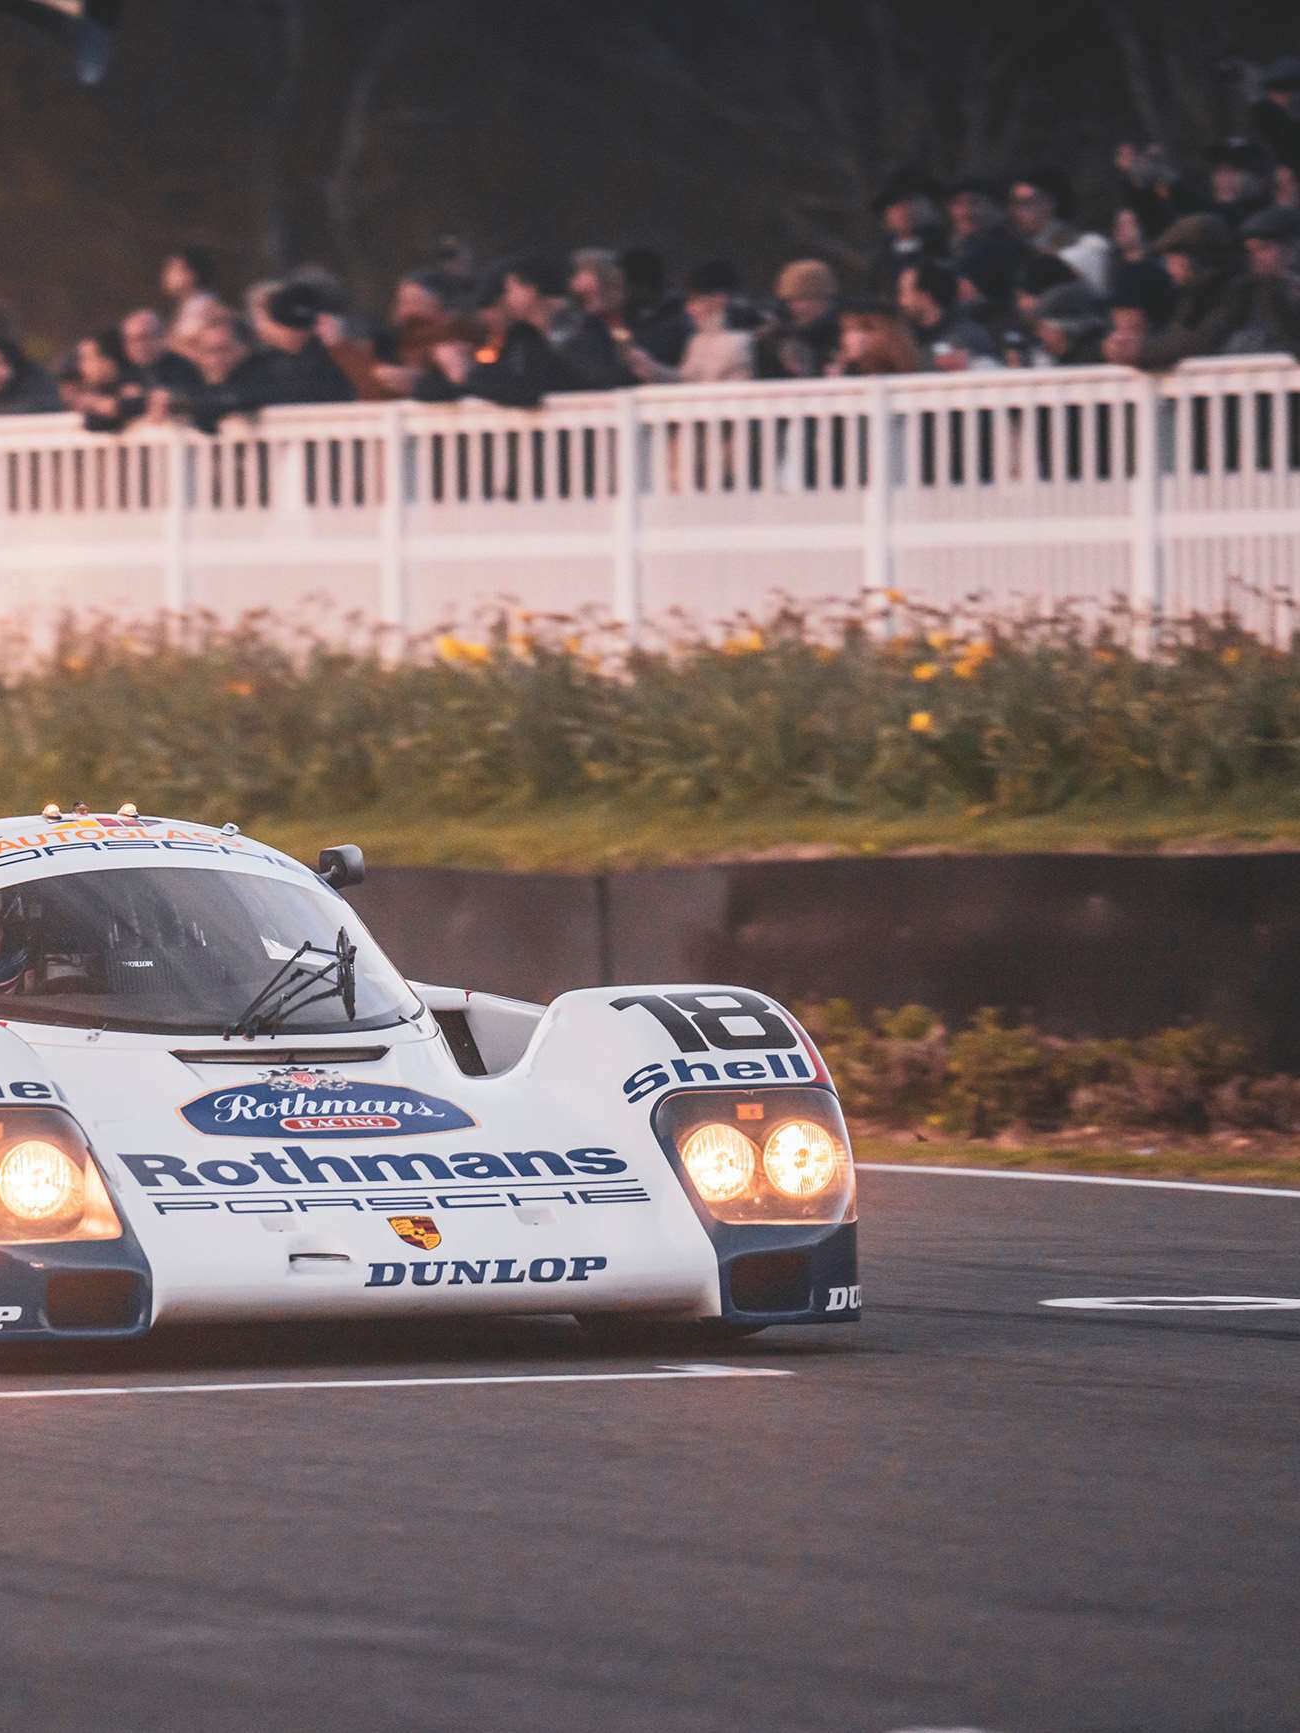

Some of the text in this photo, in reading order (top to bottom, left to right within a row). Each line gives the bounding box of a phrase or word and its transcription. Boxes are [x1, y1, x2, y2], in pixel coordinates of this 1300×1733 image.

[608, 991, 798, 1053] 18
[622, 1054, 812, 1105] Shell
[213, 1093, 446, 1123] Rothmans
[299, 1117, 385, 1130] RACING
[117, 1146, 628, 1188] Rothmans
[153, 1187, 651, 1216] PORSCHE
[364, 1256, 608, 1287] DUNLOP
[825, 1284, 862, 1312] DU
